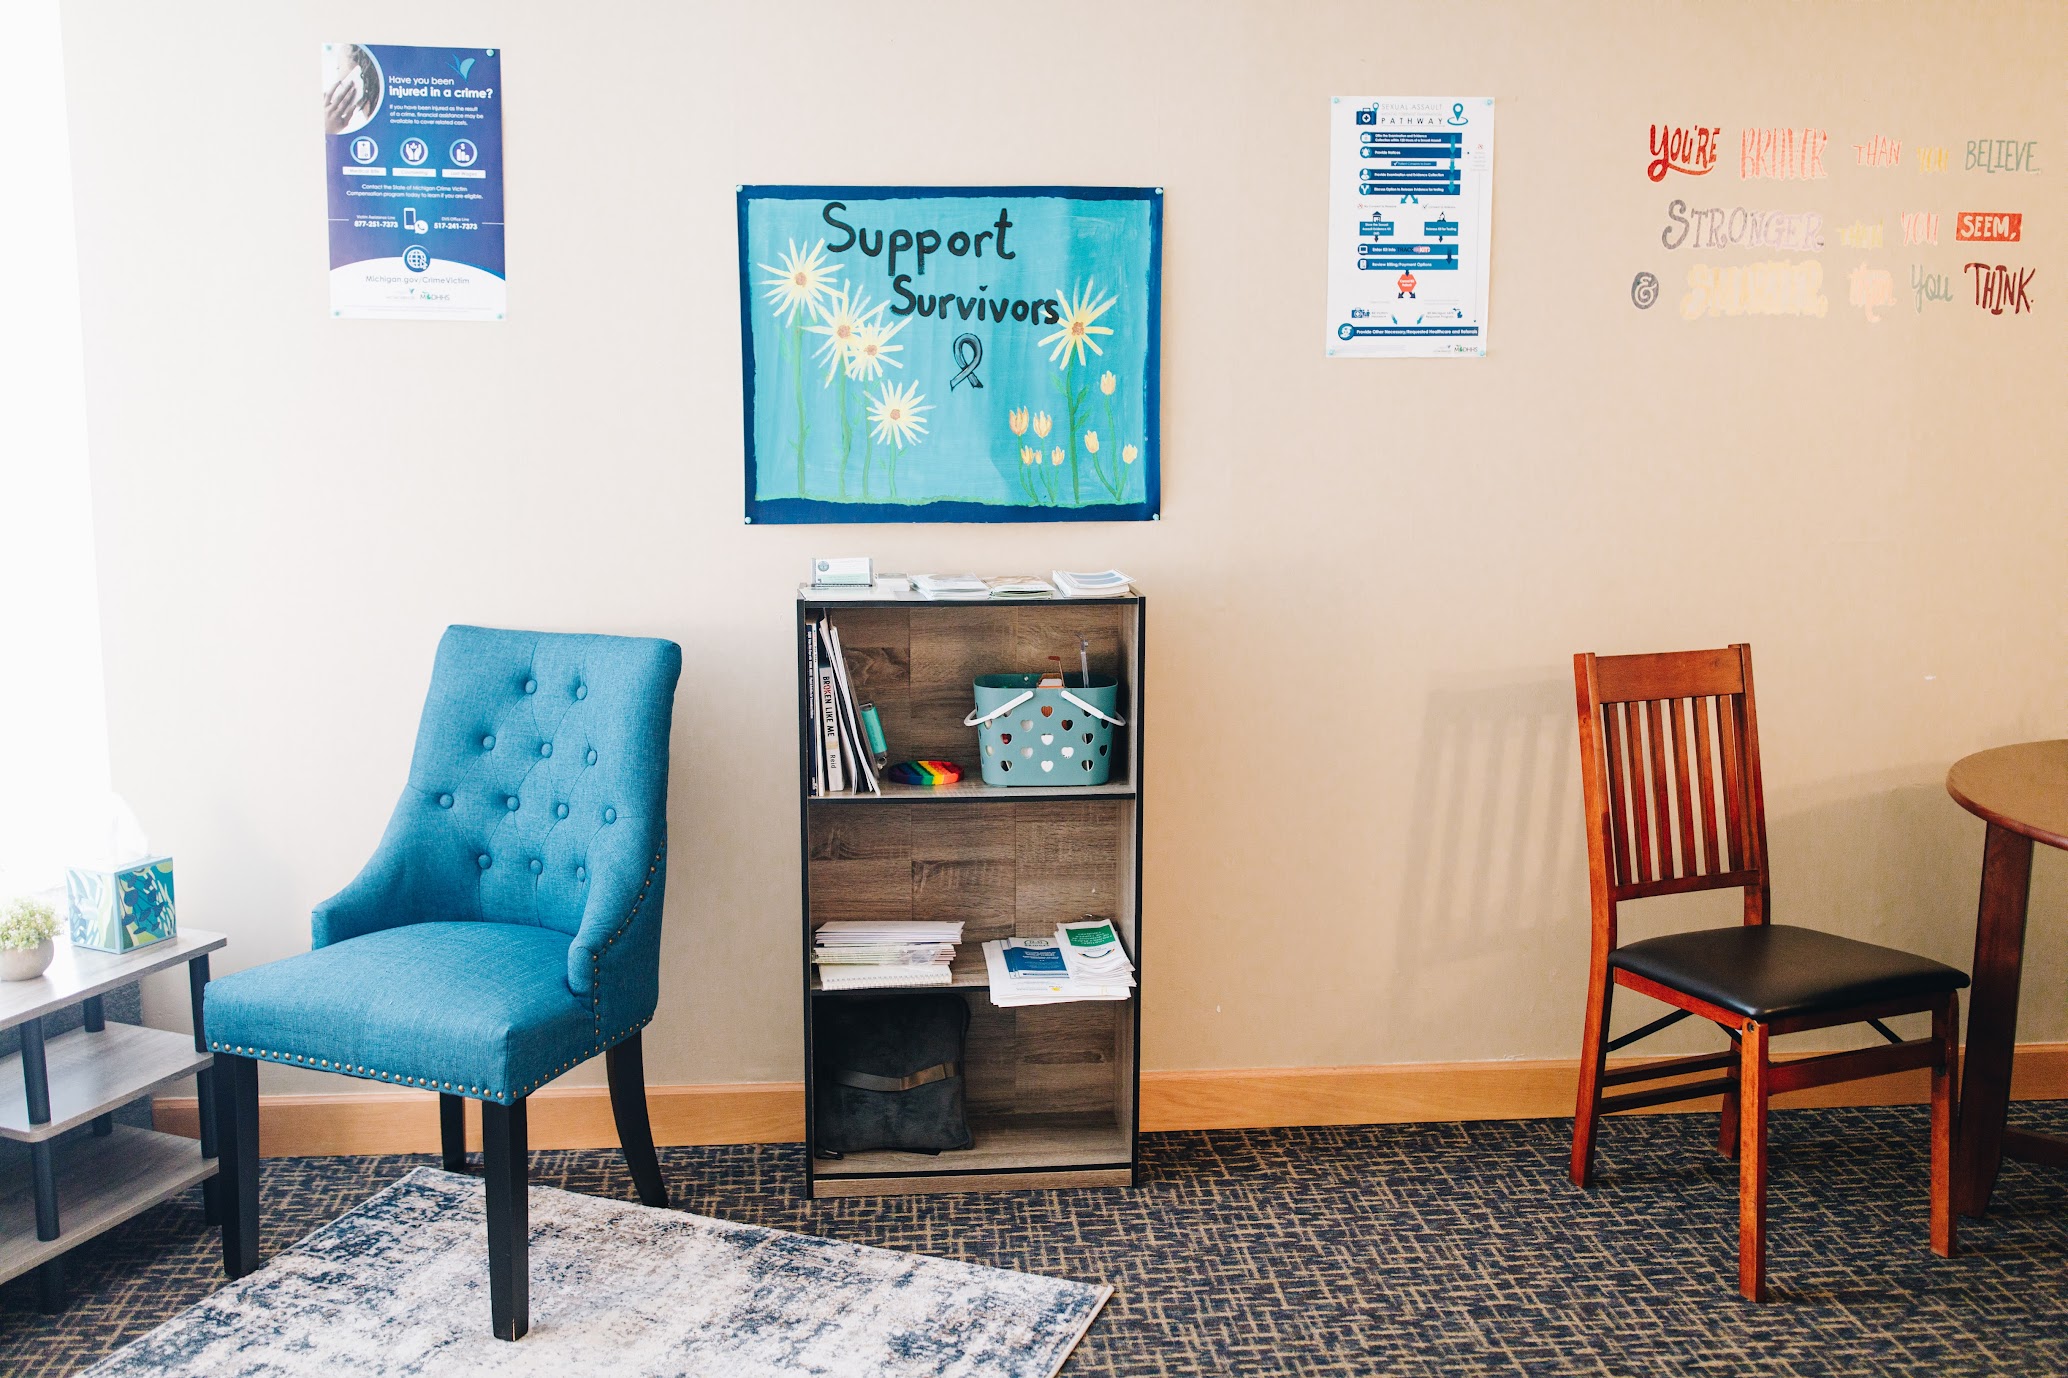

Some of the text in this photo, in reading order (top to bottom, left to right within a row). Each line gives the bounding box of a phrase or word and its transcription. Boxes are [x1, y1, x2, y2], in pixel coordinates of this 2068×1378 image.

[388, 76, 454, 86] Have you been
[389, 86, 493, 98] injured in a crime?
[1382, 103, 1442, 111] SEXUAL ASSAULT
[1647, 124, 1721, 183] YOU'RE
[1853, 134, 1902, 167] THAN
[434, 222, 477, 230] 517-241-7373
[823, 201, 1016, 277] Support
[1661, 199, 1825, 252] STRONGER
[1901, 211, 1940, 247] YOU
[1960, 214, 2017, 240] SEEM,
[890, 274, 1060, 326] Survivors
[1964, 263, 2036, 316] THINK.
[822, 676, 835, 737] BROKEN LIKE ME
